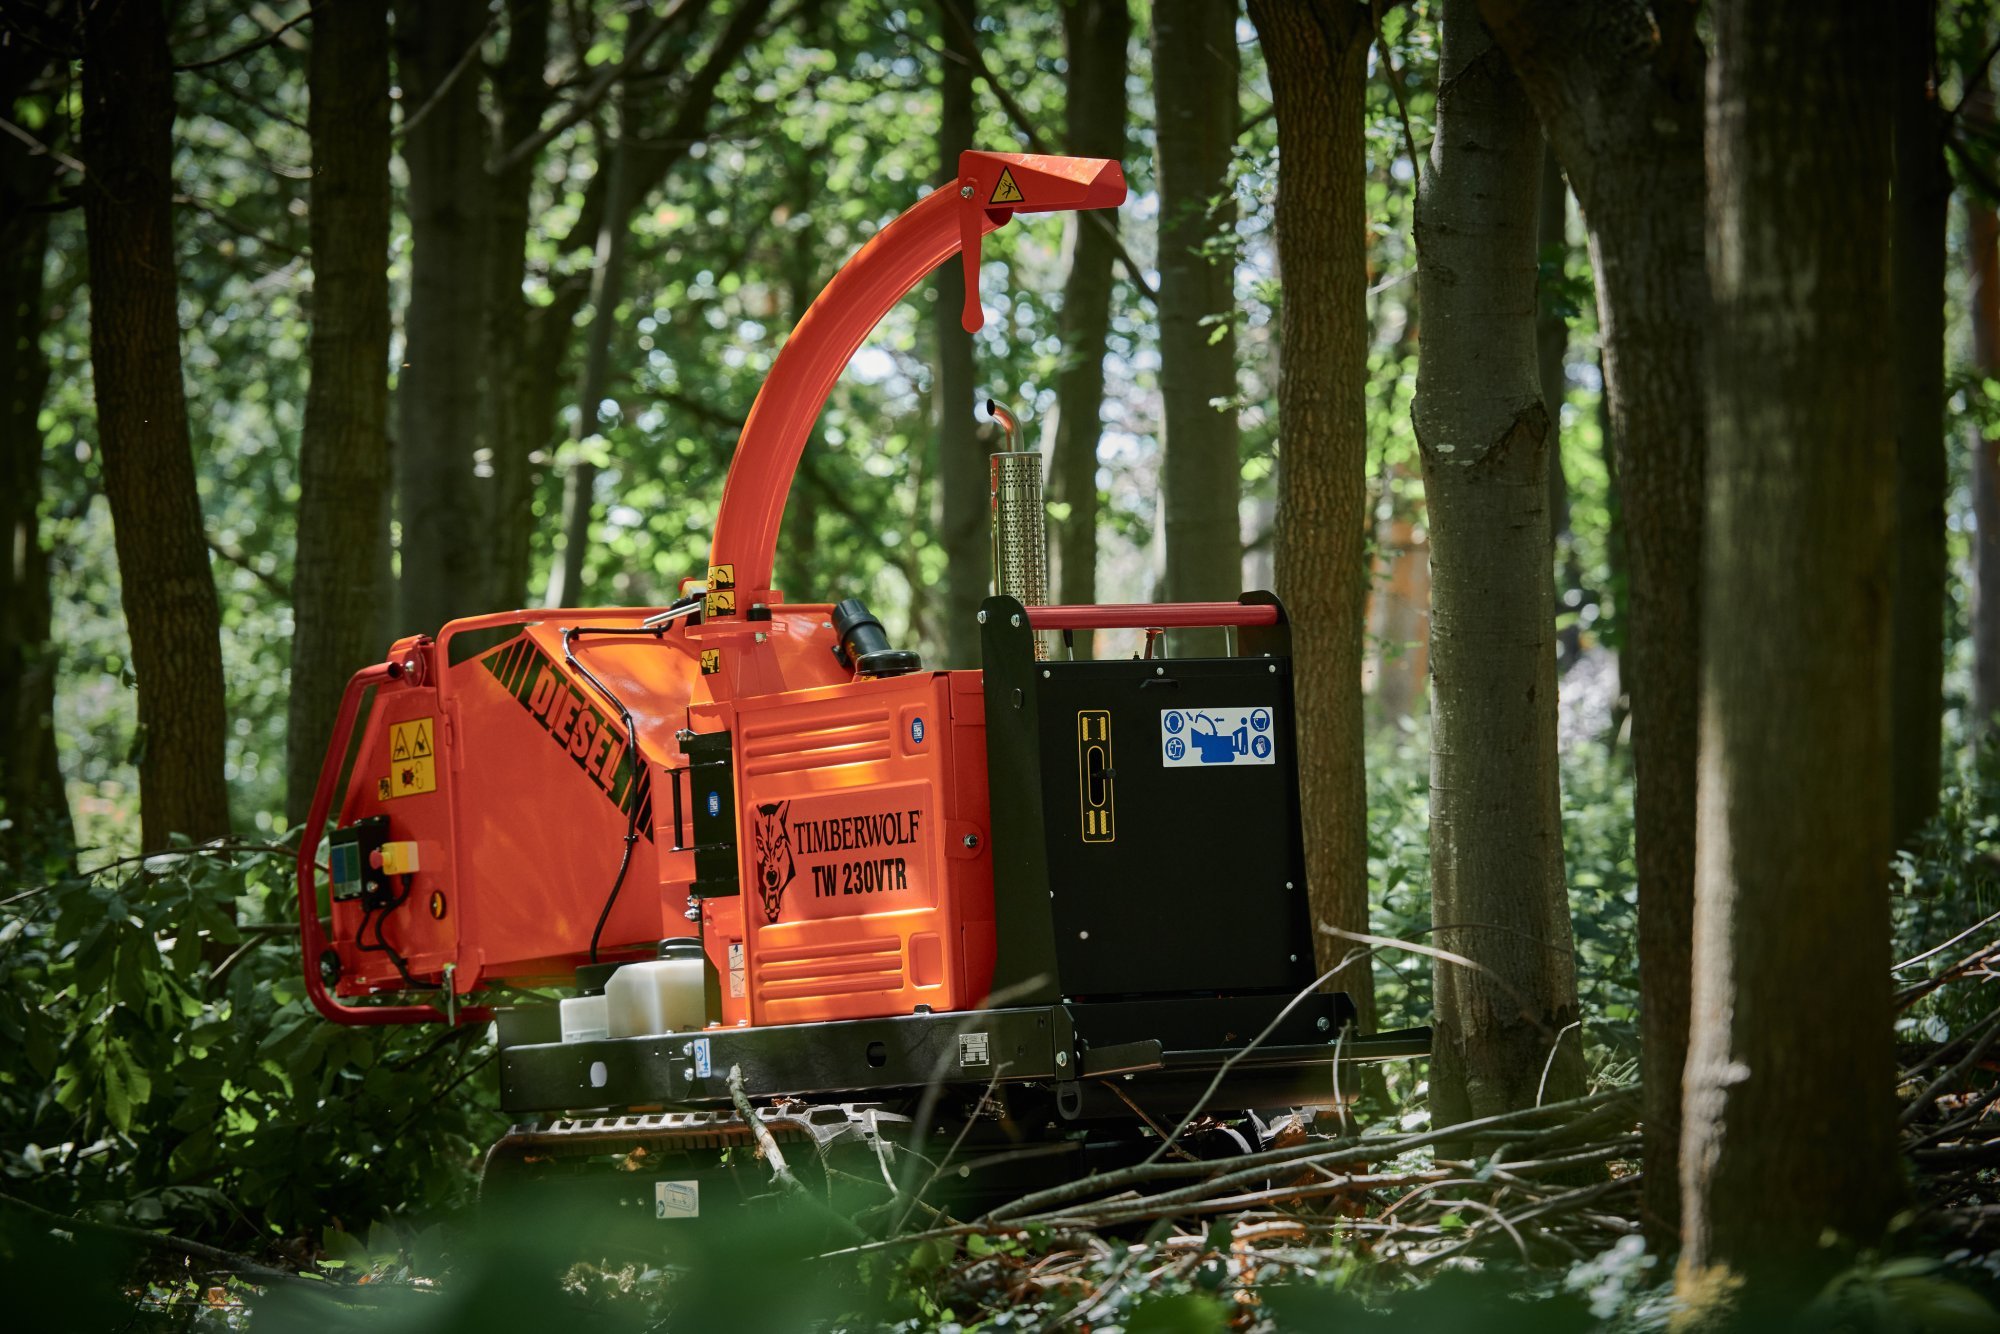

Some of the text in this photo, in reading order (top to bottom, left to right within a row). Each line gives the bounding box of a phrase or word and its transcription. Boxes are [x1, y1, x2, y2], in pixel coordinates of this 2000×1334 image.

[528, 664, 623, 792] DIESEL
[793, 810, 920, 855] TIMBERWOLF
[812, 857, 908, 897] TW 230VTR
